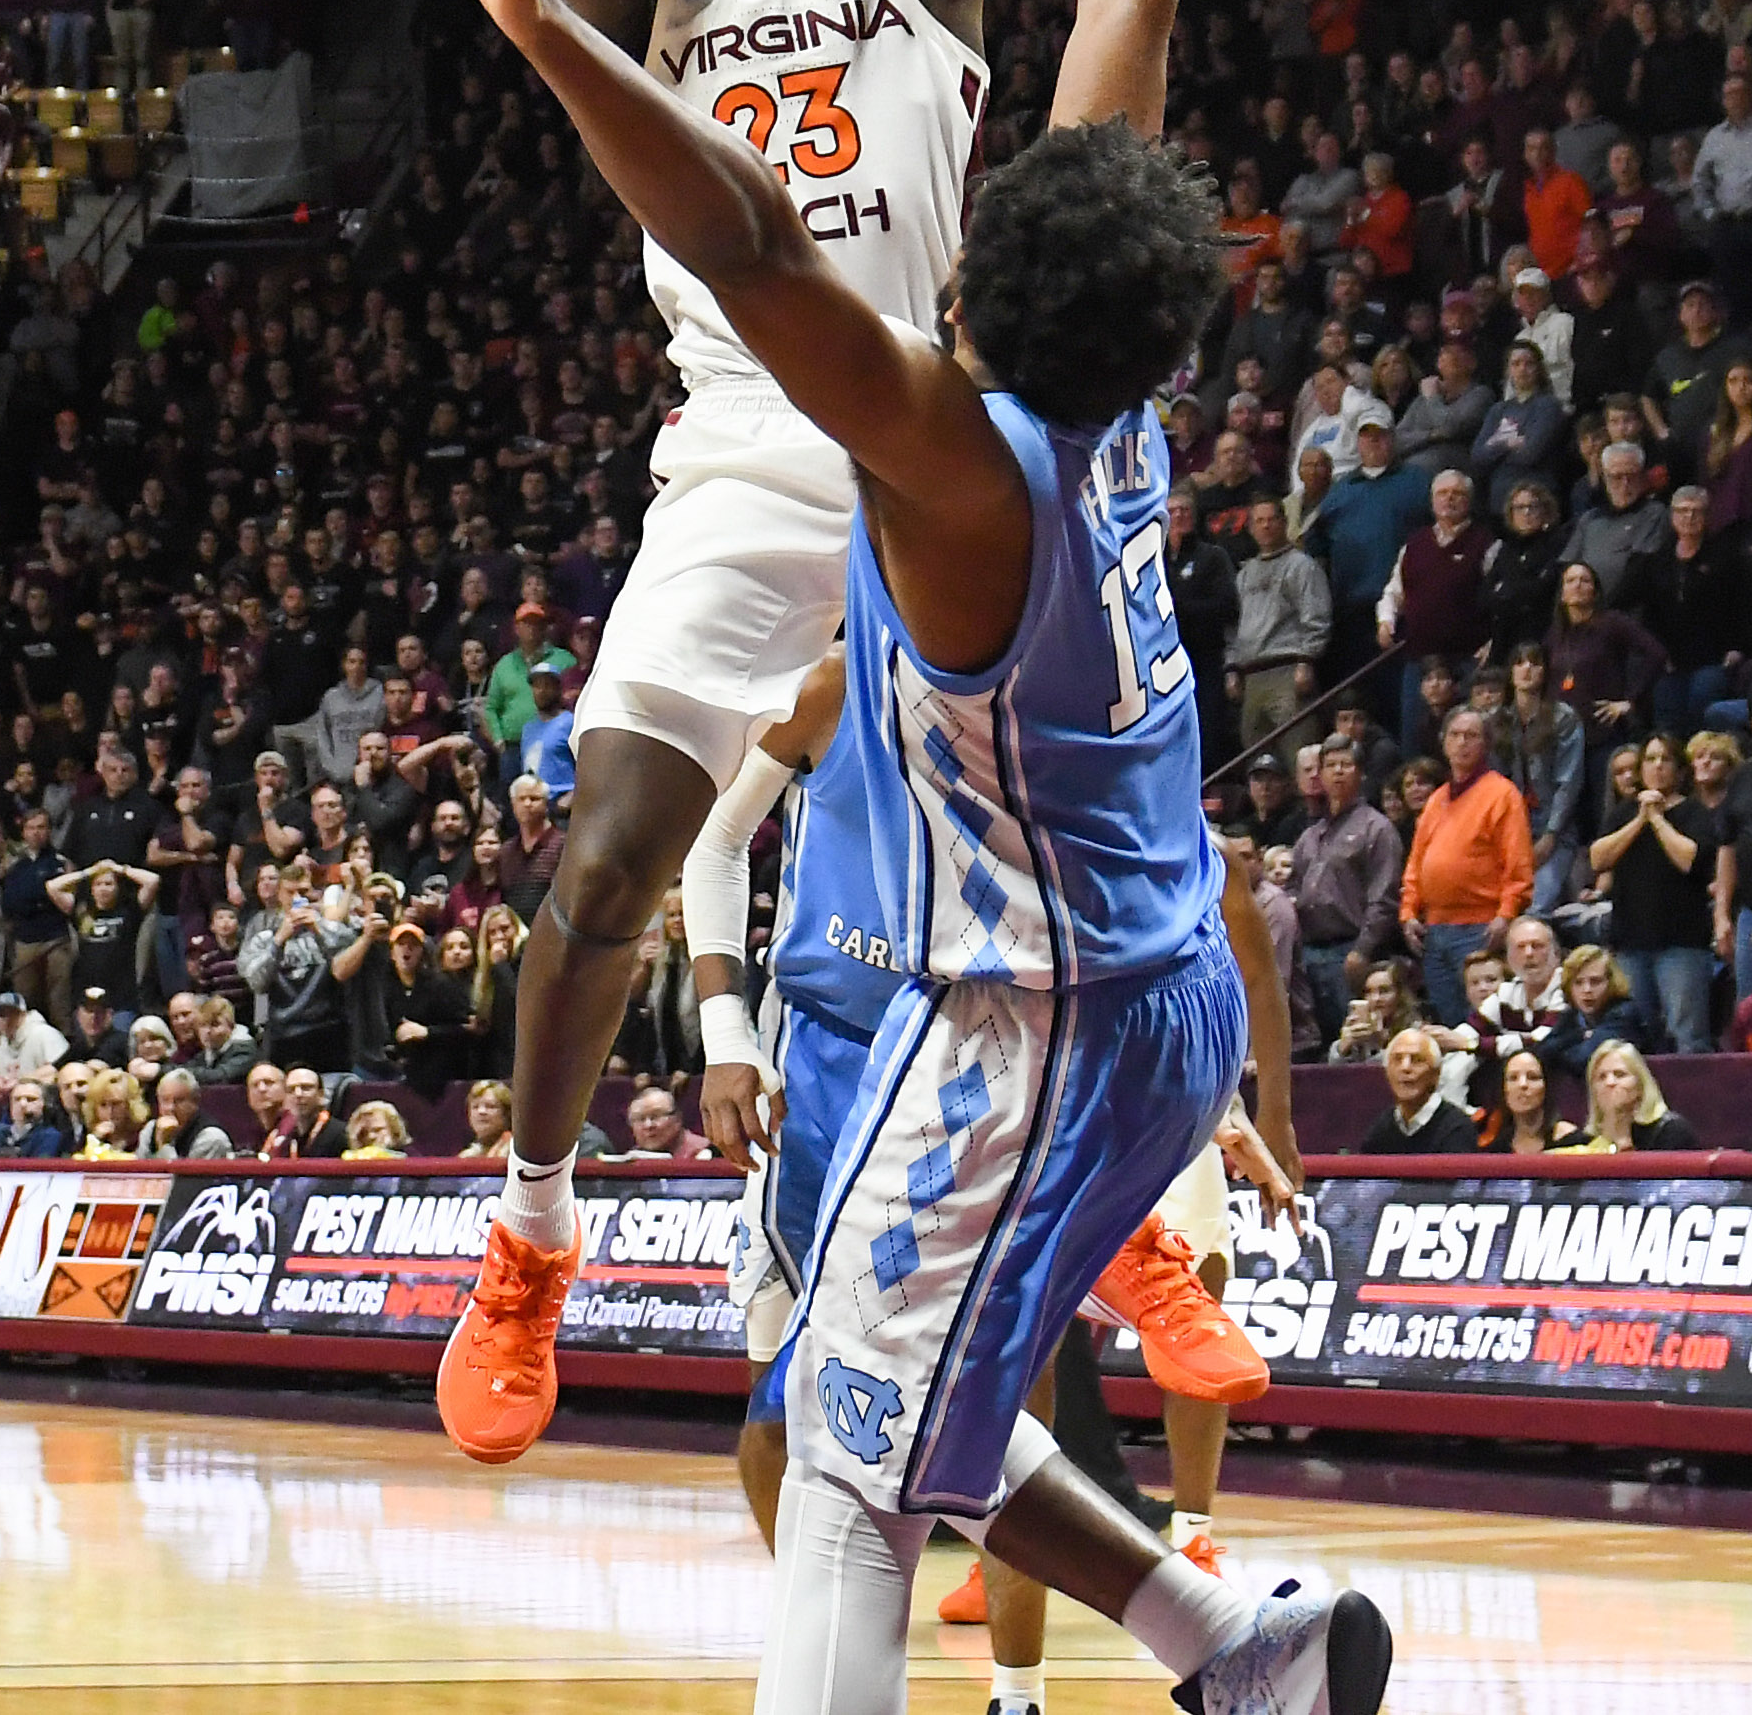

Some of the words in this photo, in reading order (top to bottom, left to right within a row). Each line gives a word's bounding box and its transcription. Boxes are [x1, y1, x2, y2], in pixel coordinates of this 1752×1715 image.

[712, 61, 862, 186] 23
[800, 188, 891, 241] CH
[1100, 516, 1195, 737] 13
[292, 1195, 384, 1254] PEST
[610, 1197, 746, 1265] SERVIC
[1366, 1204, 1510, 1279] PEST
[135, 1249, 276, 1316] PMSI
[1344, 1312, 1537, 1363] 540.315.9735
[1532, 1321, 1731, 1373] MyPMSI.com
